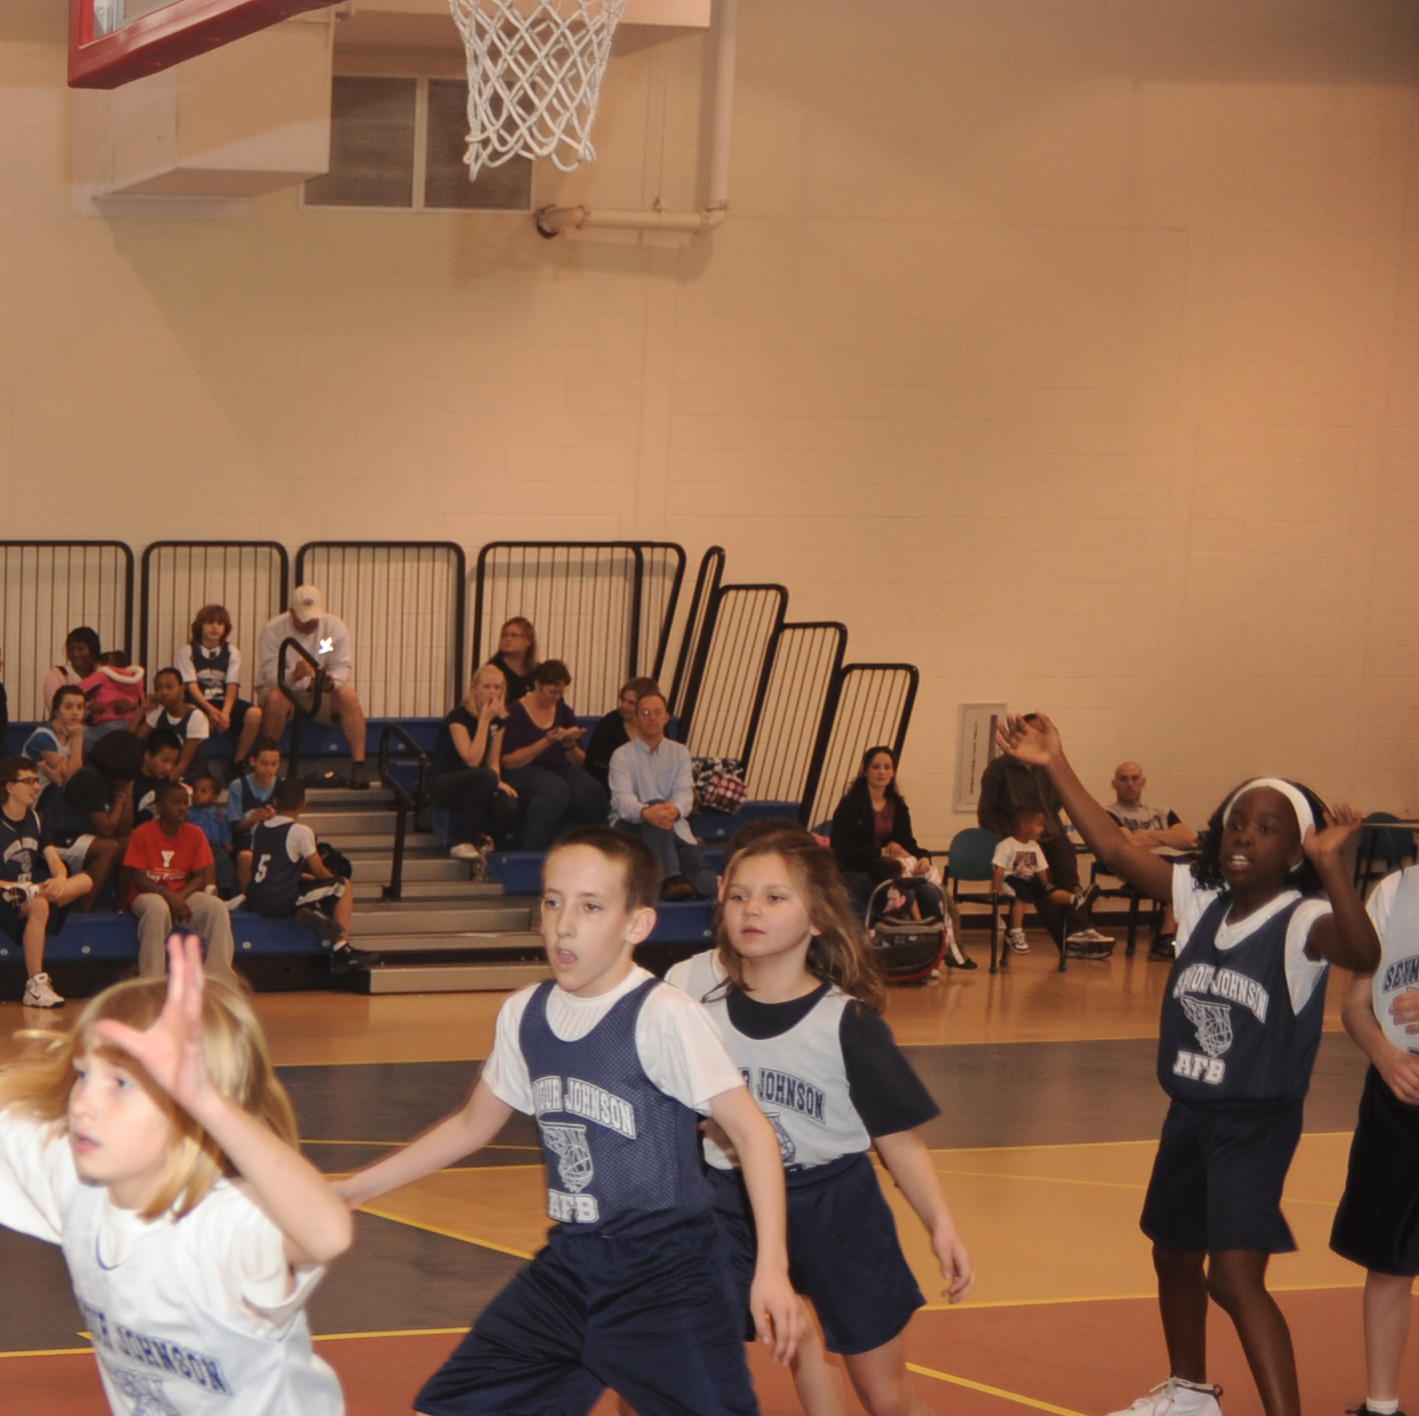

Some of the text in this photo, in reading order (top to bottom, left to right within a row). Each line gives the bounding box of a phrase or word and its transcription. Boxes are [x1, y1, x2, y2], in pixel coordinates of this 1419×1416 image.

[254, 853, 272, 884] 5
[1173, 1050, 1226, 1085] AFB
[565, 1077, 637, 1140] JOHNSON
[759, 1068, 826, 1125] JOHNSON
[548, 1188, 600, 1224] AFB
[114, 1321, 234, 1397] JOHNSON
